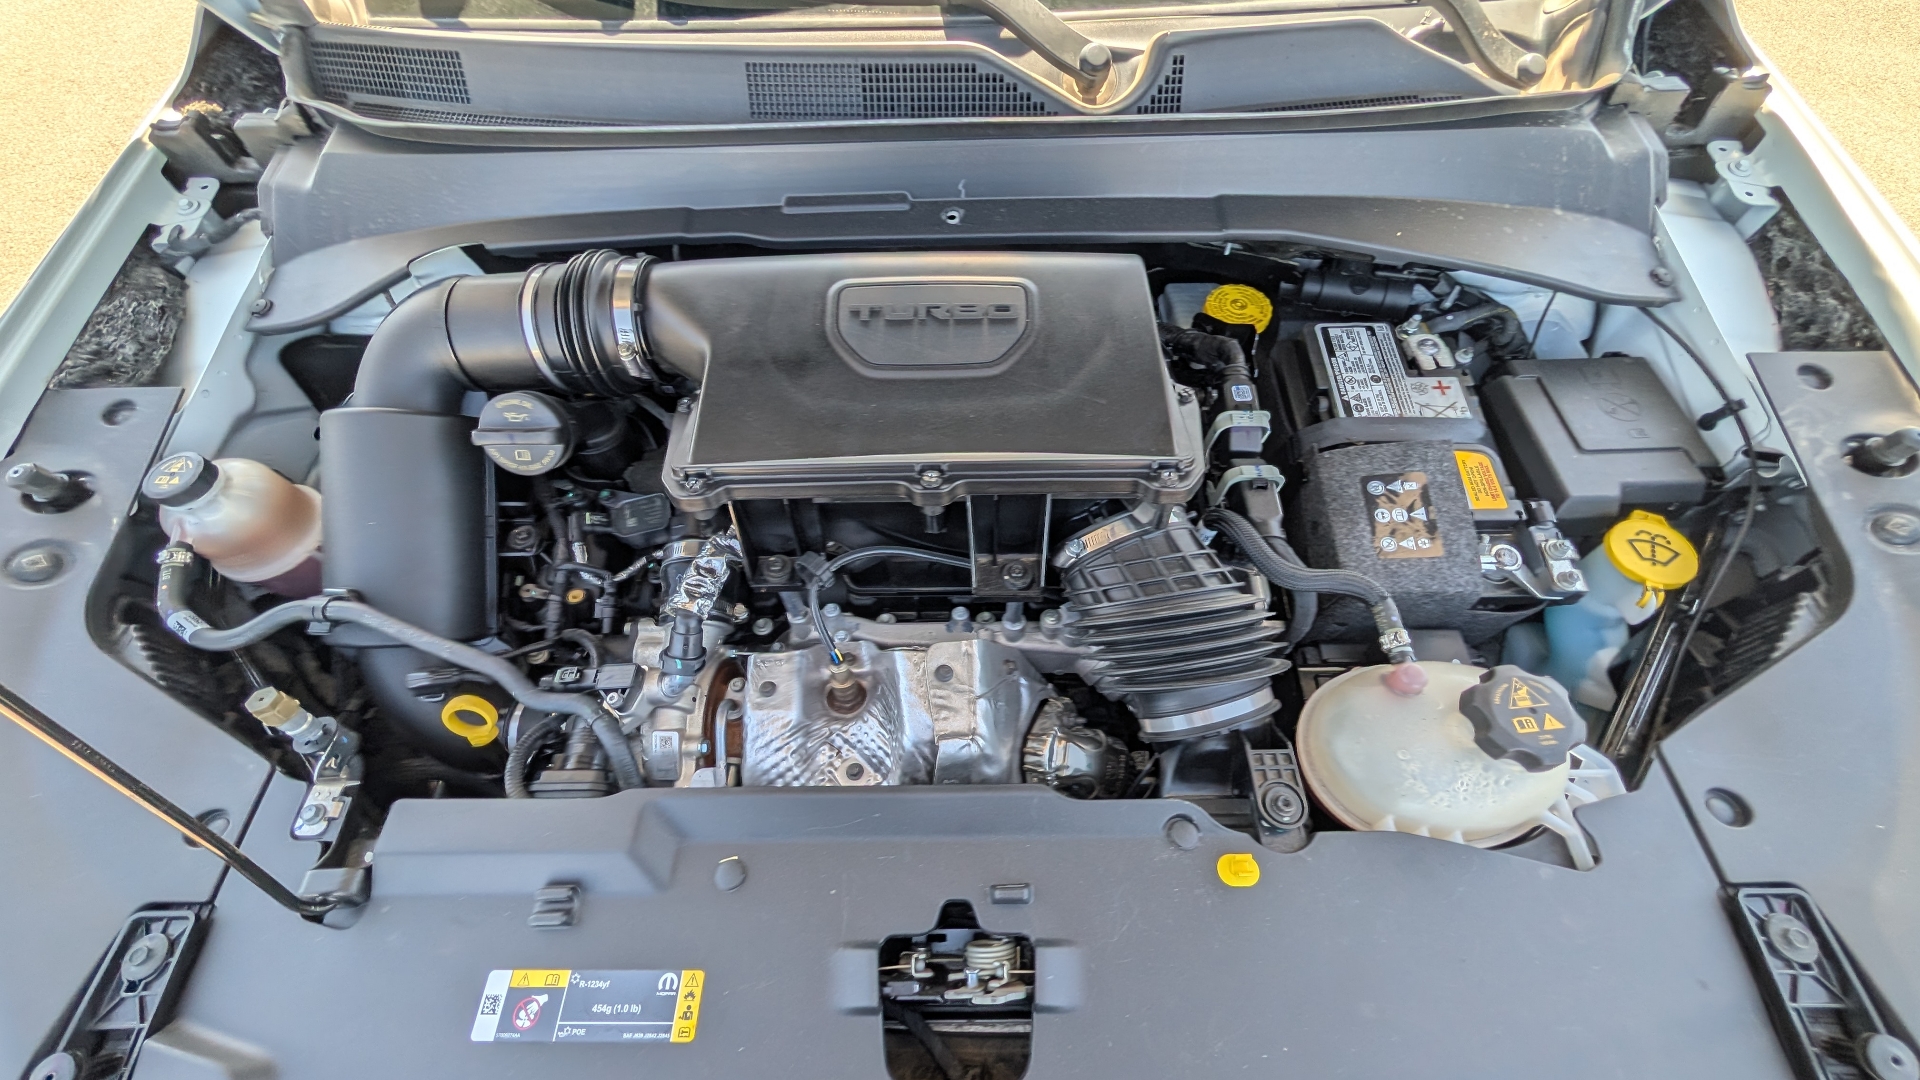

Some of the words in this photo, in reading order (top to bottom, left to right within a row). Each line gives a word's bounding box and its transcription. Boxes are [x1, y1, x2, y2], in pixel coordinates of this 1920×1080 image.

[848, 302, 1019, 321] TURBO
[579, 980, 610, 989] R-1234yf
[592, 1004, 612, 1015] 454g
[613, 1004, 629, 1015] (1.0
[631, 1004, 642, 1015] lb)
[572, 1028, 586, 1036] POE
